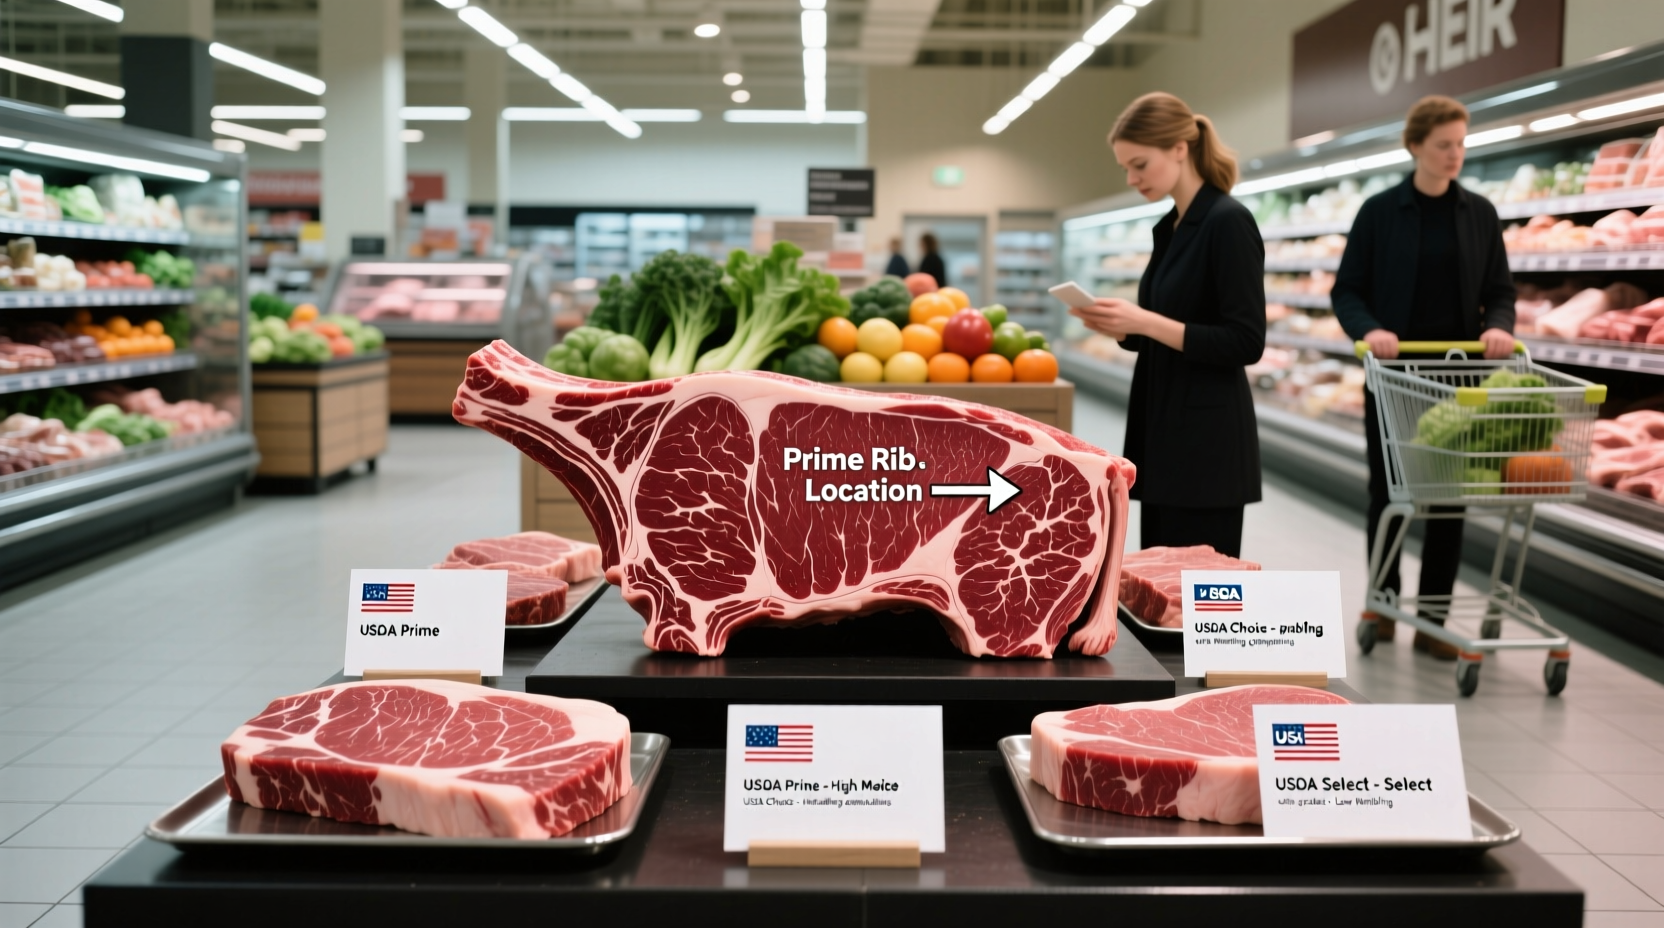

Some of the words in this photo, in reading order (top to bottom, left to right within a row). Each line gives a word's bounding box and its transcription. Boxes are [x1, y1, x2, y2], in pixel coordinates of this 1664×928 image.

[360, 624, 397, 637] USDA
[401, 623, 440, 637] Prime
[1195, 622, 1228, 634] USDA
[1275, 776, 1318, 791] USDA
[1322, 776, 1370, 792] Select
[1384, 776, 1433, 792] Select
